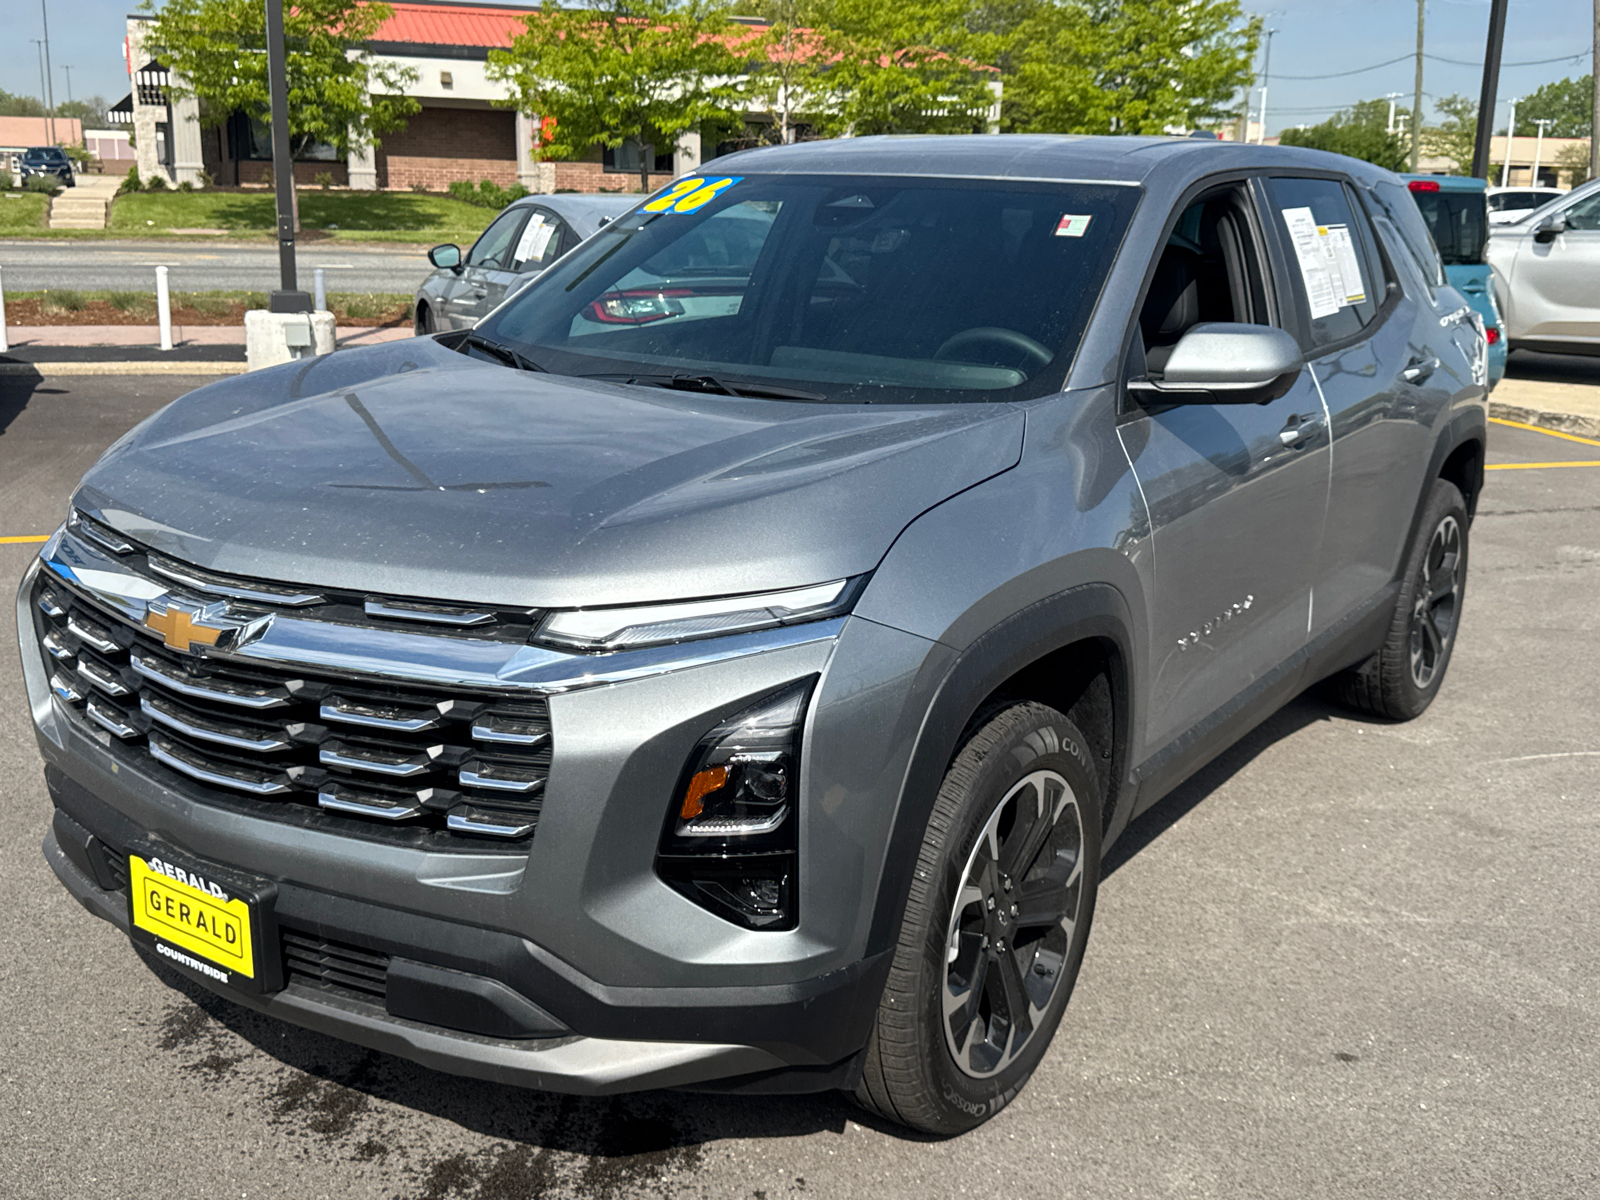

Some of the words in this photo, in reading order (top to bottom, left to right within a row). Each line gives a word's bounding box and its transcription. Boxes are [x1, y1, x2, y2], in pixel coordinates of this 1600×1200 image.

[643, 177, 733, 212] 26
[151, 857, 224, 900] GERALD
[150, 890, 237, 944] GERALD
[156, 943, 229, 984] COUNTRYSIDE
